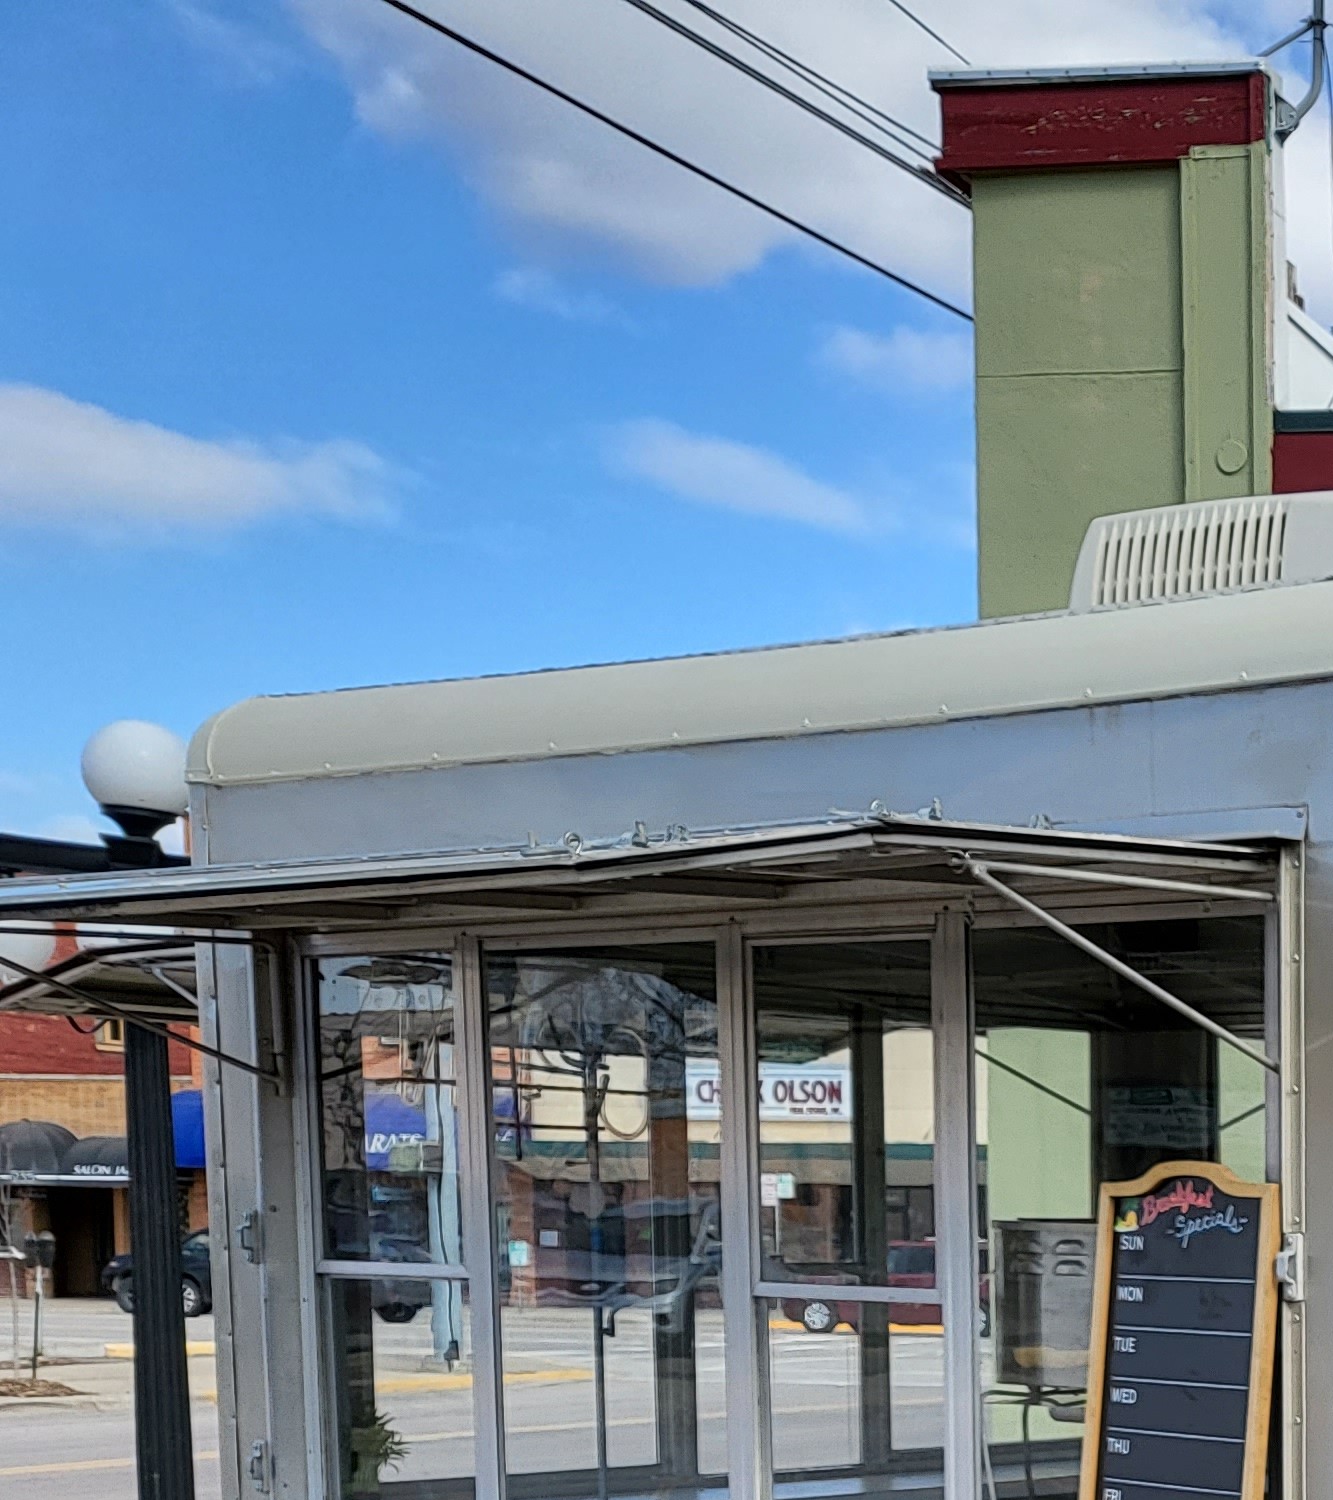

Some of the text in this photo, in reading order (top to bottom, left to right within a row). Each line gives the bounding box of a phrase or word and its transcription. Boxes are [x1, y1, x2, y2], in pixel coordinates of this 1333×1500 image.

[773, 1080, 843, 1104] OLSON
[73, 1164, 111, 1175] SALON
[1120, 1233, 1144, 1250] SUN
[1116, 1285, 1144, 1302] MON
[1113, 1336, 1137, 1353] TUE
[1110, 1387, 1137, 1404] WED
[1107, 1437, 1130, 1455] THU
